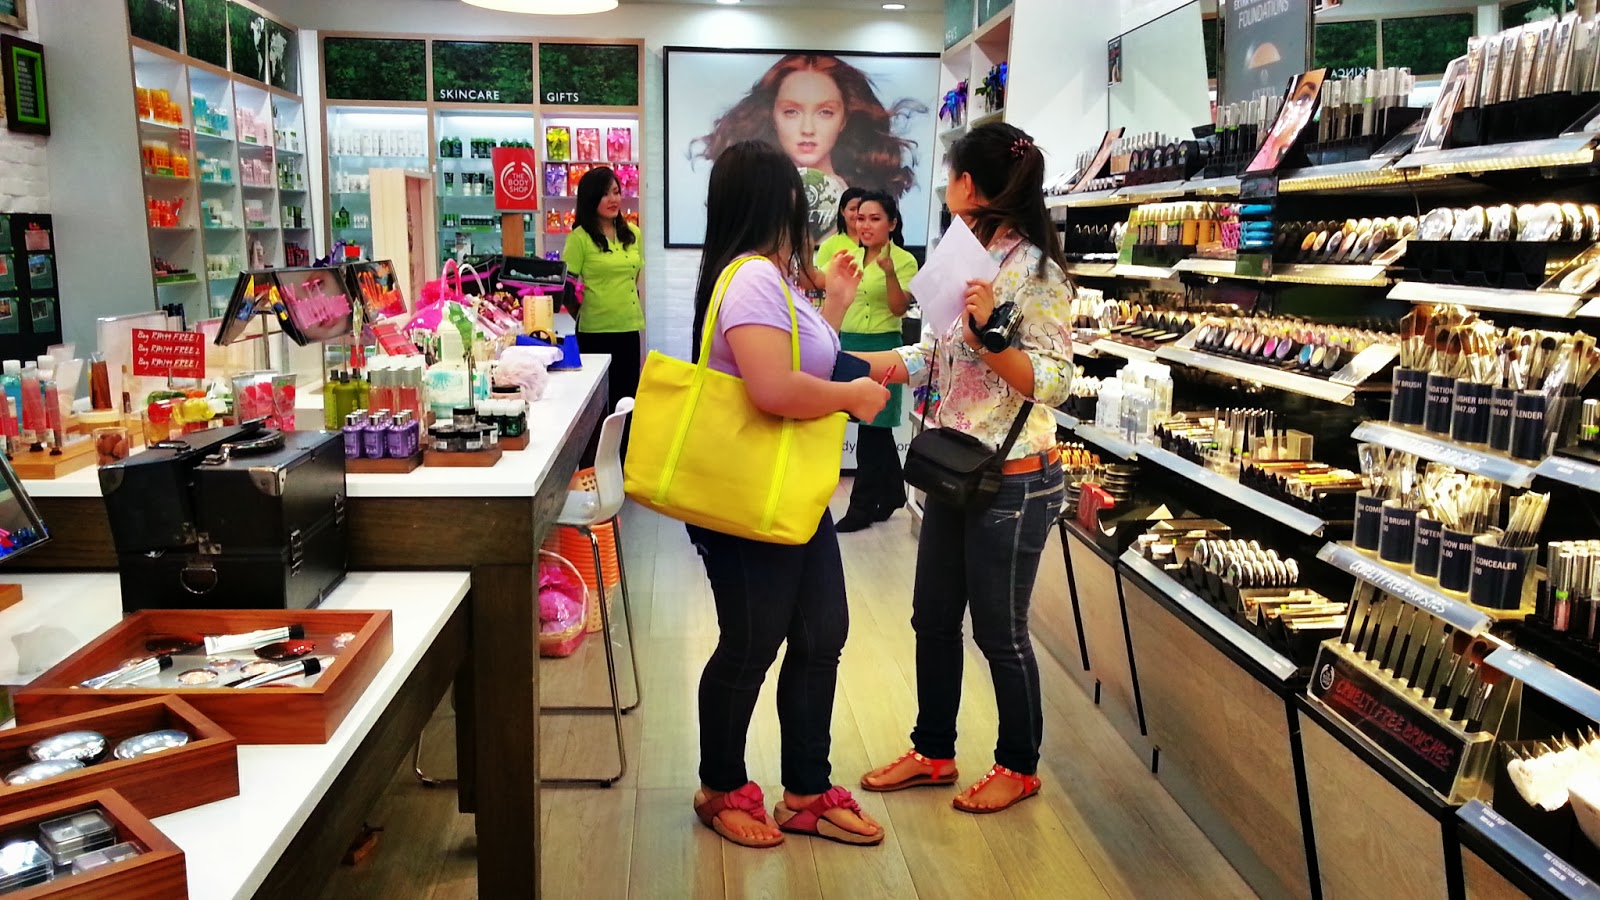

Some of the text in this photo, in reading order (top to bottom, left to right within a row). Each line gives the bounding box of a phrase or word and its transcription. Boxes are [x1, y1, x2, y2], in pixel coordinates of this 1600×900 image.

[439, 89, 500, 100] SKINCARE
[546, 92, 579, 102] GIFTS
[173, 333, 195, 342] FREE
[174, 345, 195, 354] FREE
[174, 358, 195, 368] FREE
[1401, 381, 1422, 389] BRUSH
[1428, 386, 1454, 395] DATION
[1456, 395, 1477, 405] USHER
[1515, 410, 1543, 420] LENDER
[1388, 517, 1410, 526] BRUSH
[1419, 528, 1441, 538] SOFTEN
[1459, 542, 1475, 551] BRU
[1475, 556, 1518, 570] CONCEALER
